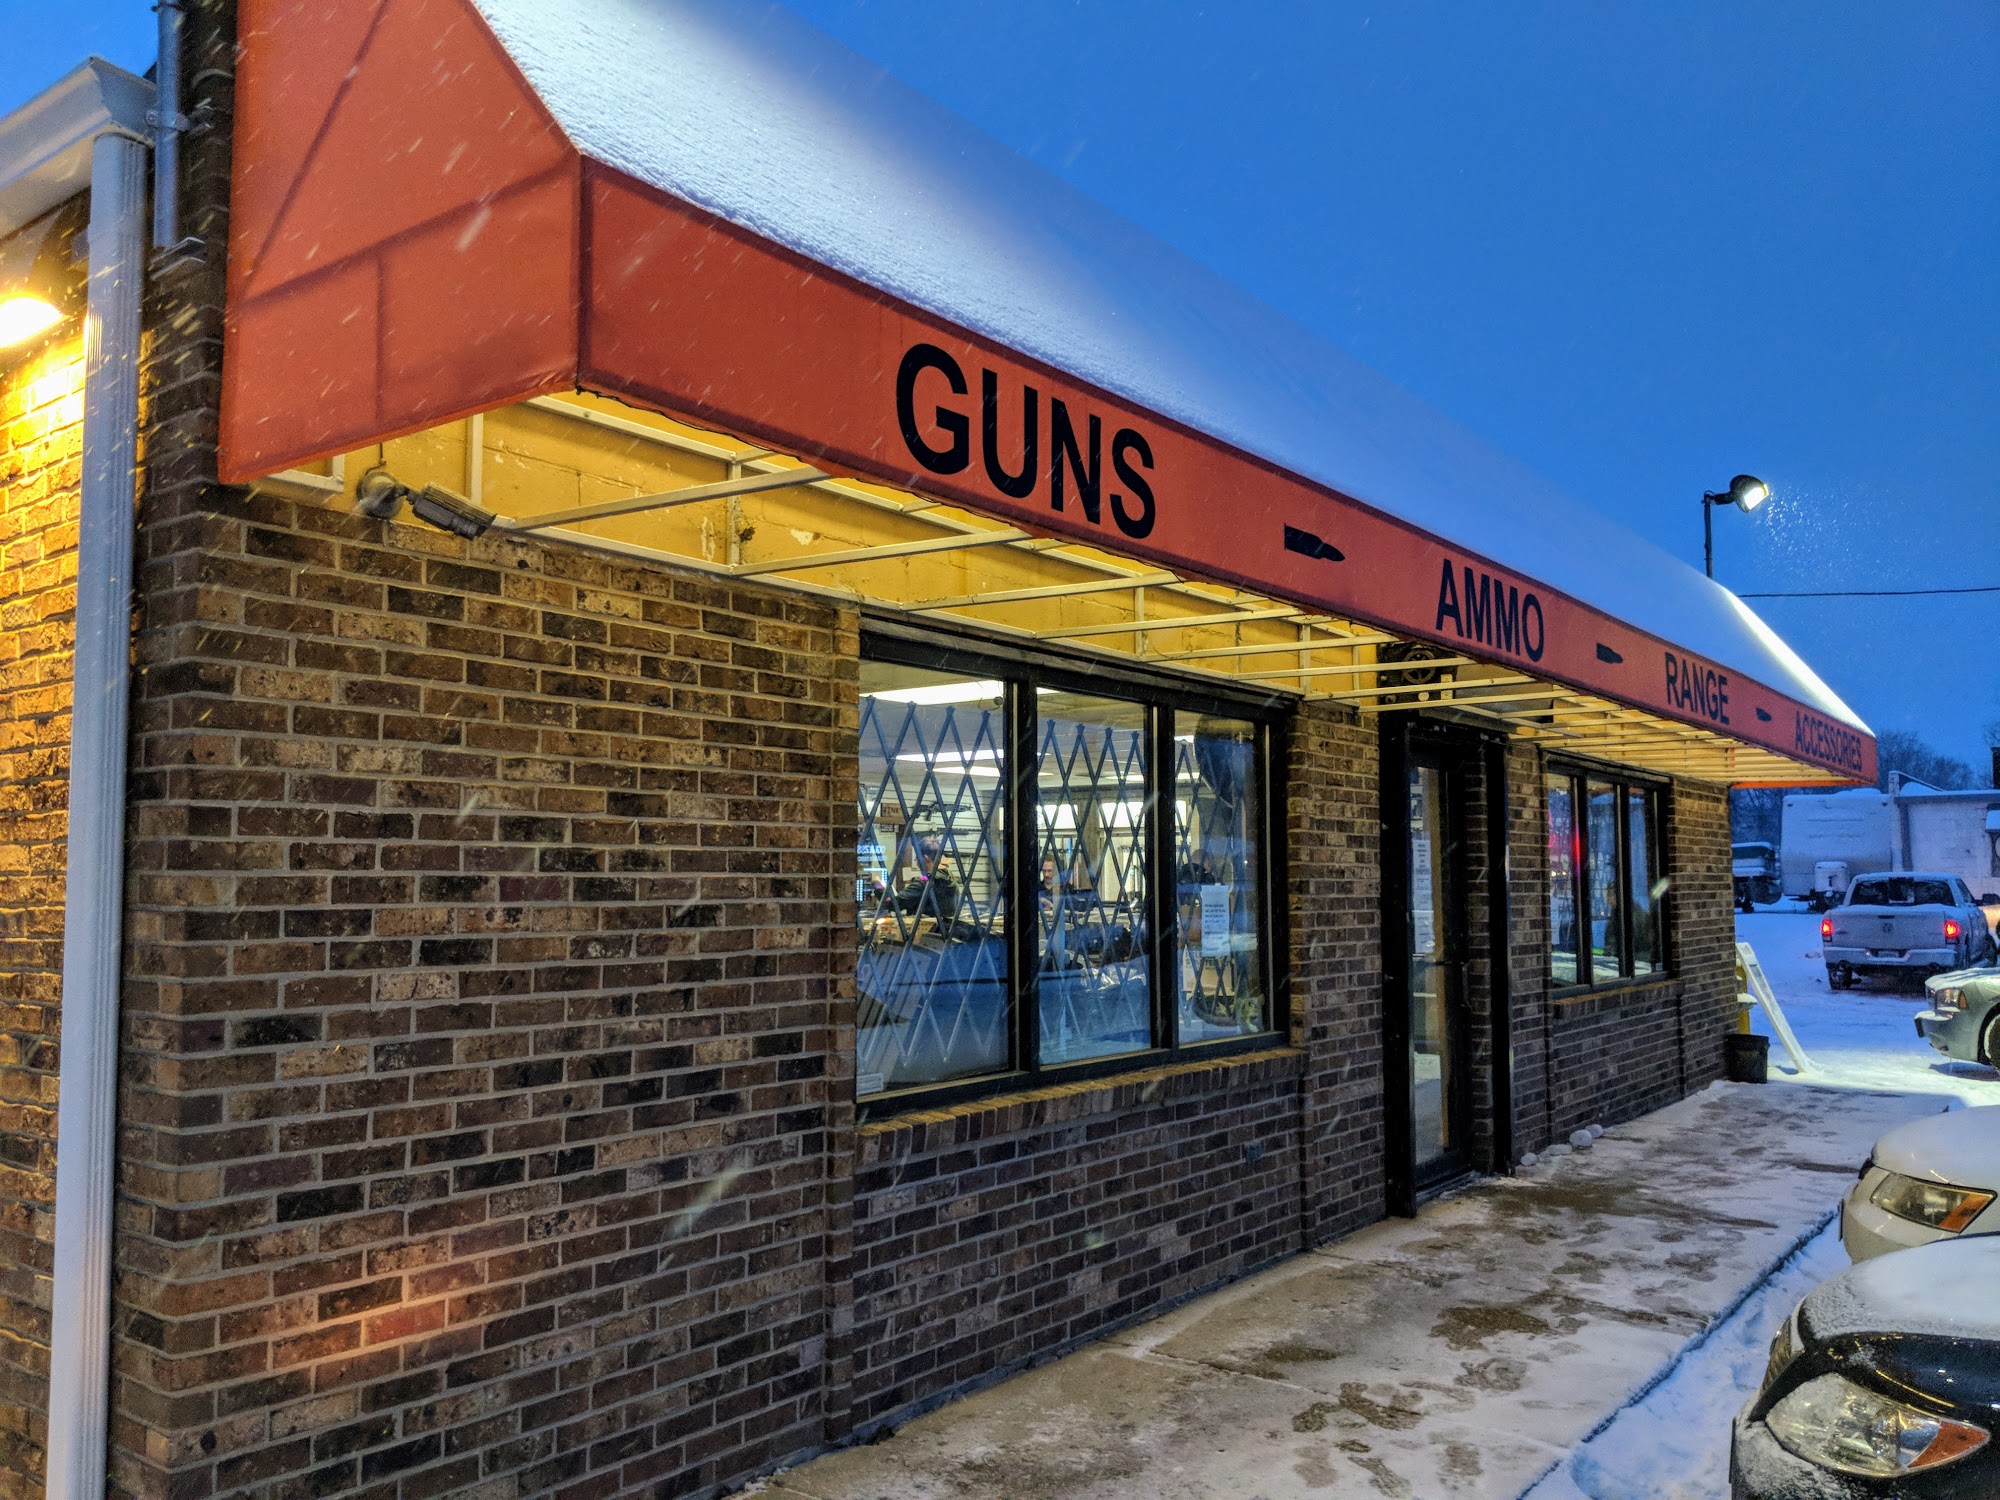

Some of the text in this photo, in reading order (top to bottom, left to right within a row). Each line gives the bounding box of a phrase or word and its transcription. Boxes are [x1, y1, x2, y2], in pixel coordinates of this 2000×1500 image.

[896, 343, 1862, 772] GUNS AMMO RANGE ACCESSORIES
